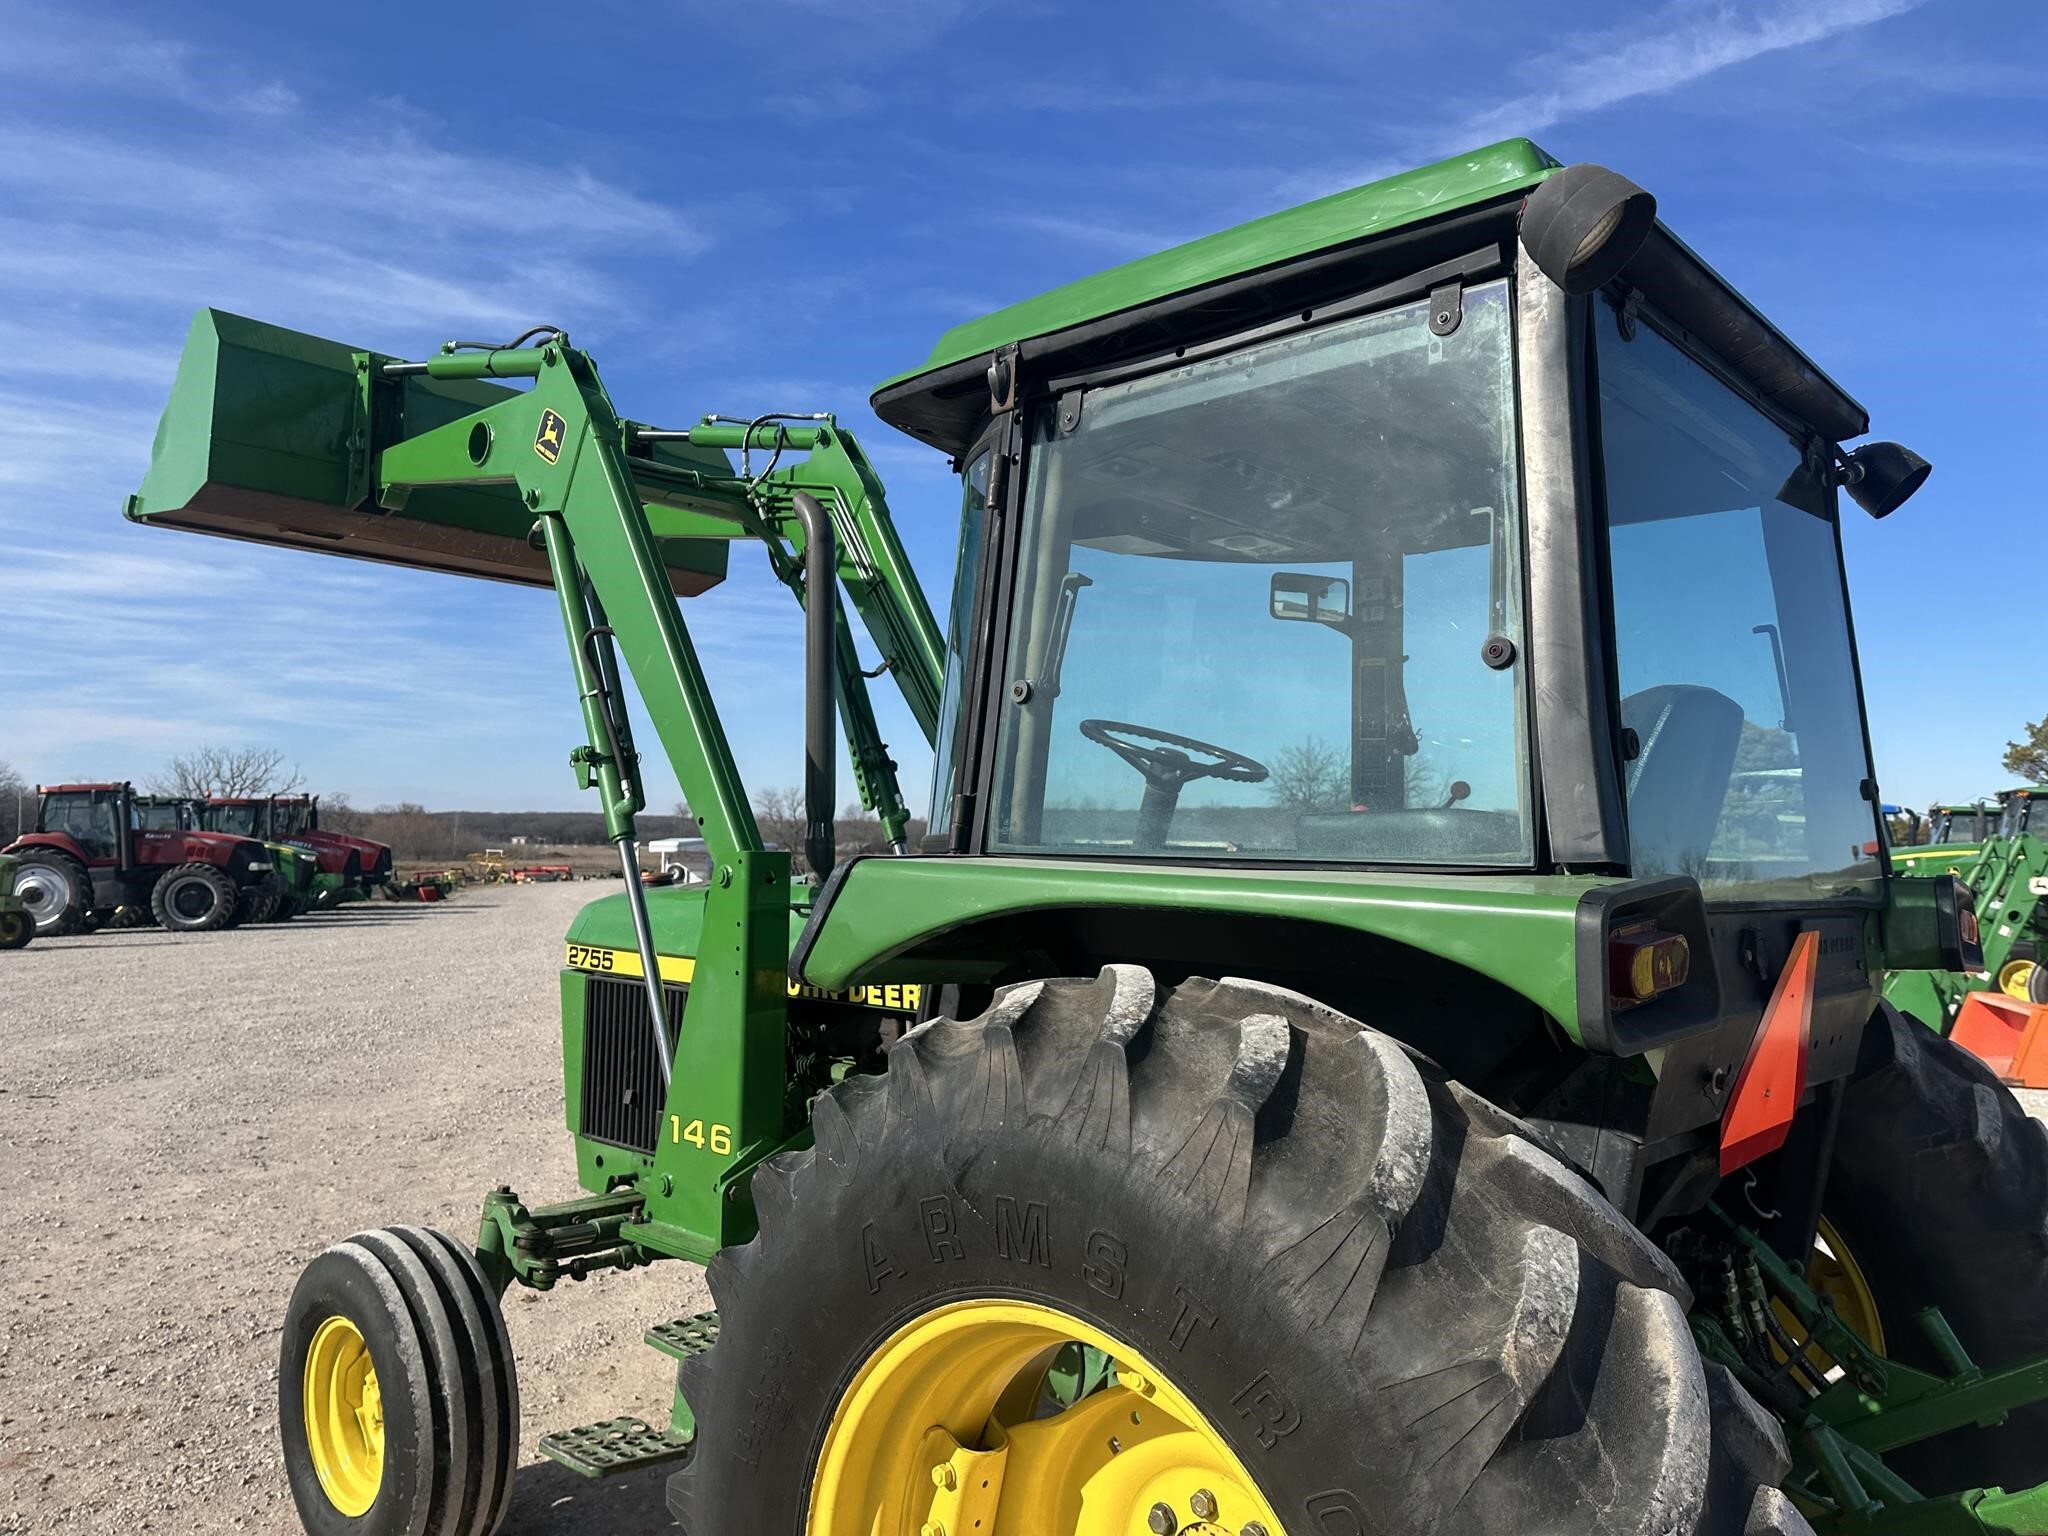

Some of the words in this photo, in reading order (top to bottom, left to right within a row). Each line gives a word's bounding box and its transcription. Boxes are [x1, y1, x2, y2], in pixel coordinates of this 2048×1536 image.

[568, 945, 614, 971] 2755
[848, 983, 921, 1010] DEER
[670, 1113, 733, 1156] 146
[861, 1194, 1380, 1536] ARMSTRO
